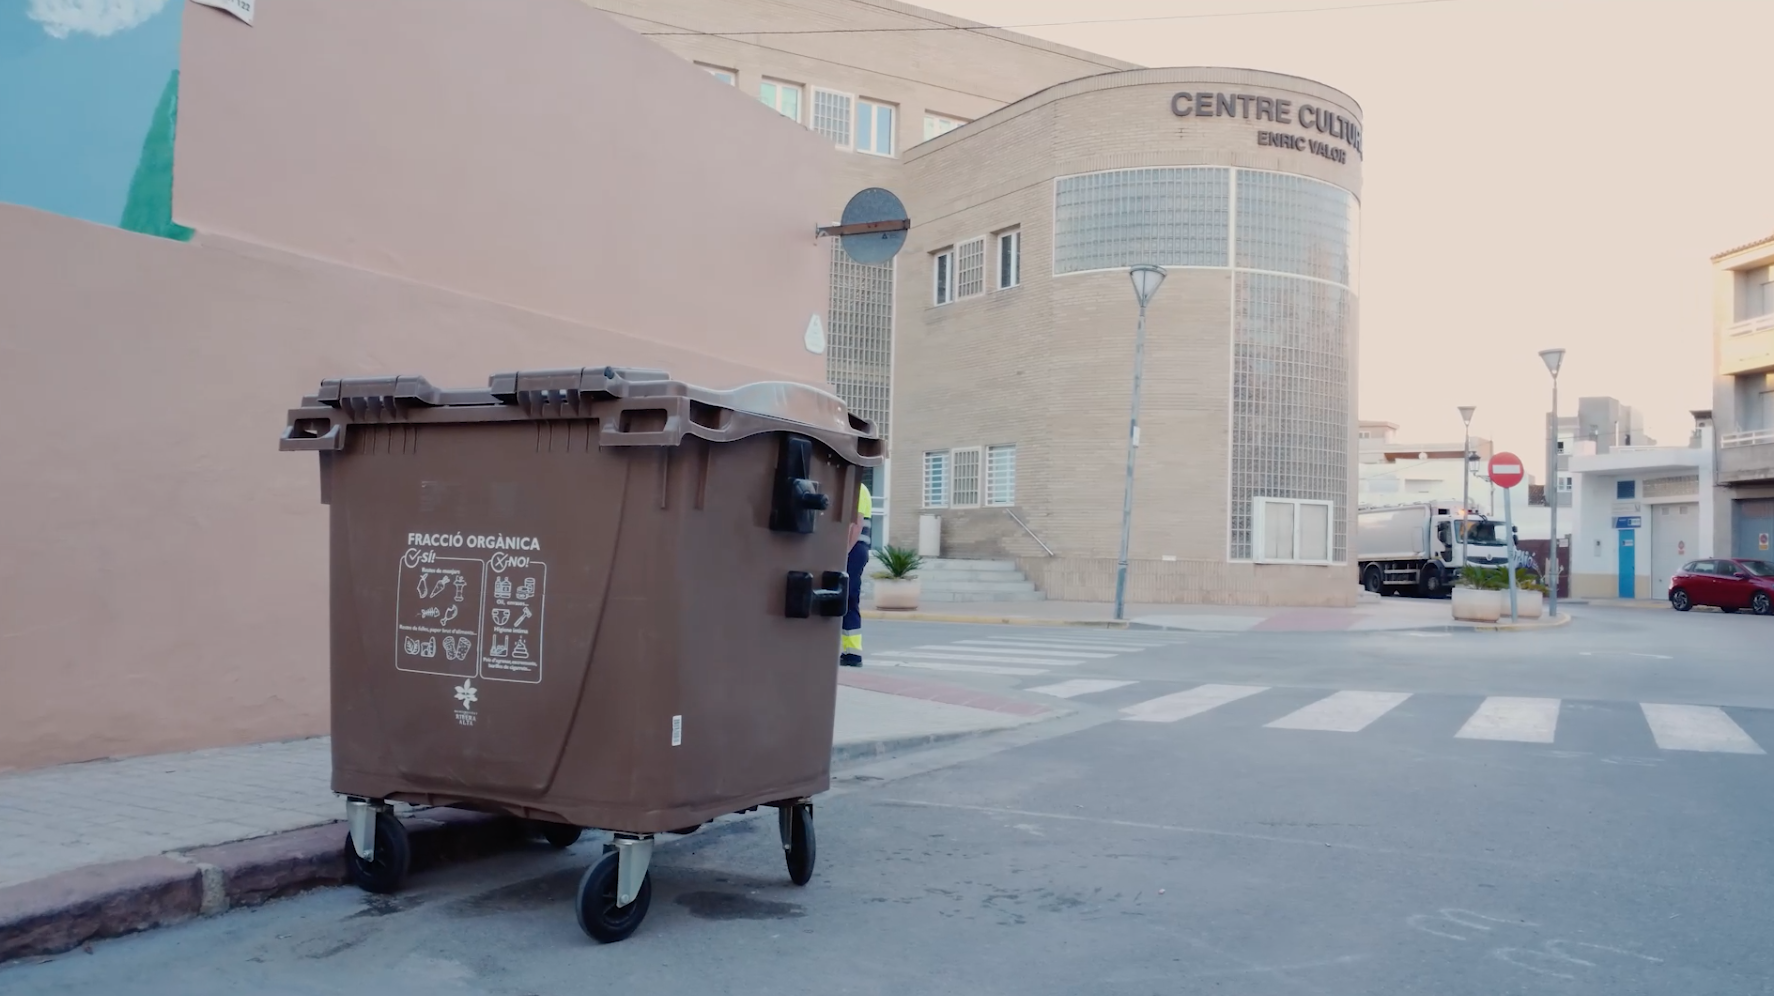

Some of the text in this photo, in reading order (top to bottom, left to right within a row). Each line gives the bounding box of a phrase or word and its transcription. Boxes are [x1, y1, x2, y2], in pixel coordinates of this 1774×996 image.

[1171, 91, 1362, 161] CENTRE CULTUR
[1257, 130, 1346, 165] ENRIC VALOR
[407, 531, 540, 551] FRACCIÓ ORGÀNICA
[508, 556, 530, 568] NO!
